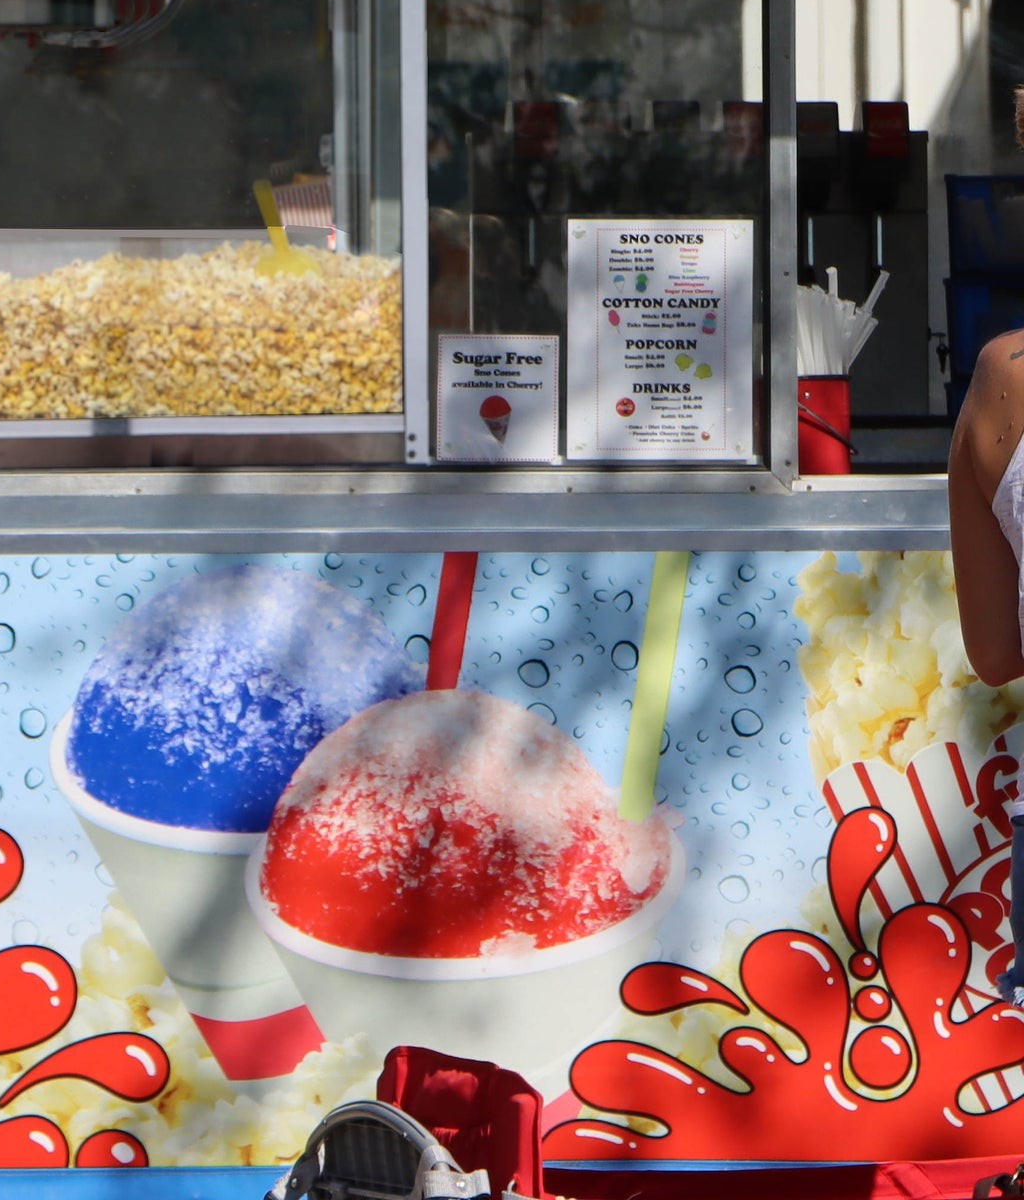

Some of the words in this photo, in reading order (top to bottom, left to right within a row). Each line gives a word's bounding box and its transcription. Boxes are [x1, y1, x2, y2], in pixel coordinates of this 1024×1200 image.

[619, 233, 650, 245] SNO
[654, 233, 704, 245] CONES
[602, 298, 664, 309] COTTON
[667, 298, 721, 309] CANDY
[624, 339, 698, 350] POPCORN
[452, 351, 502, 367] Sugar
[505, 351, 543, 366] Free
[474, 368, 491, 377] Sno
[493, 368, 521, 377] Cones
[451, 379, 494, 389] available
[495, 380, 505, 389] in
[506, 380, 543, 391] Cherry!
[632, 383, 692, 394] DRINKS
